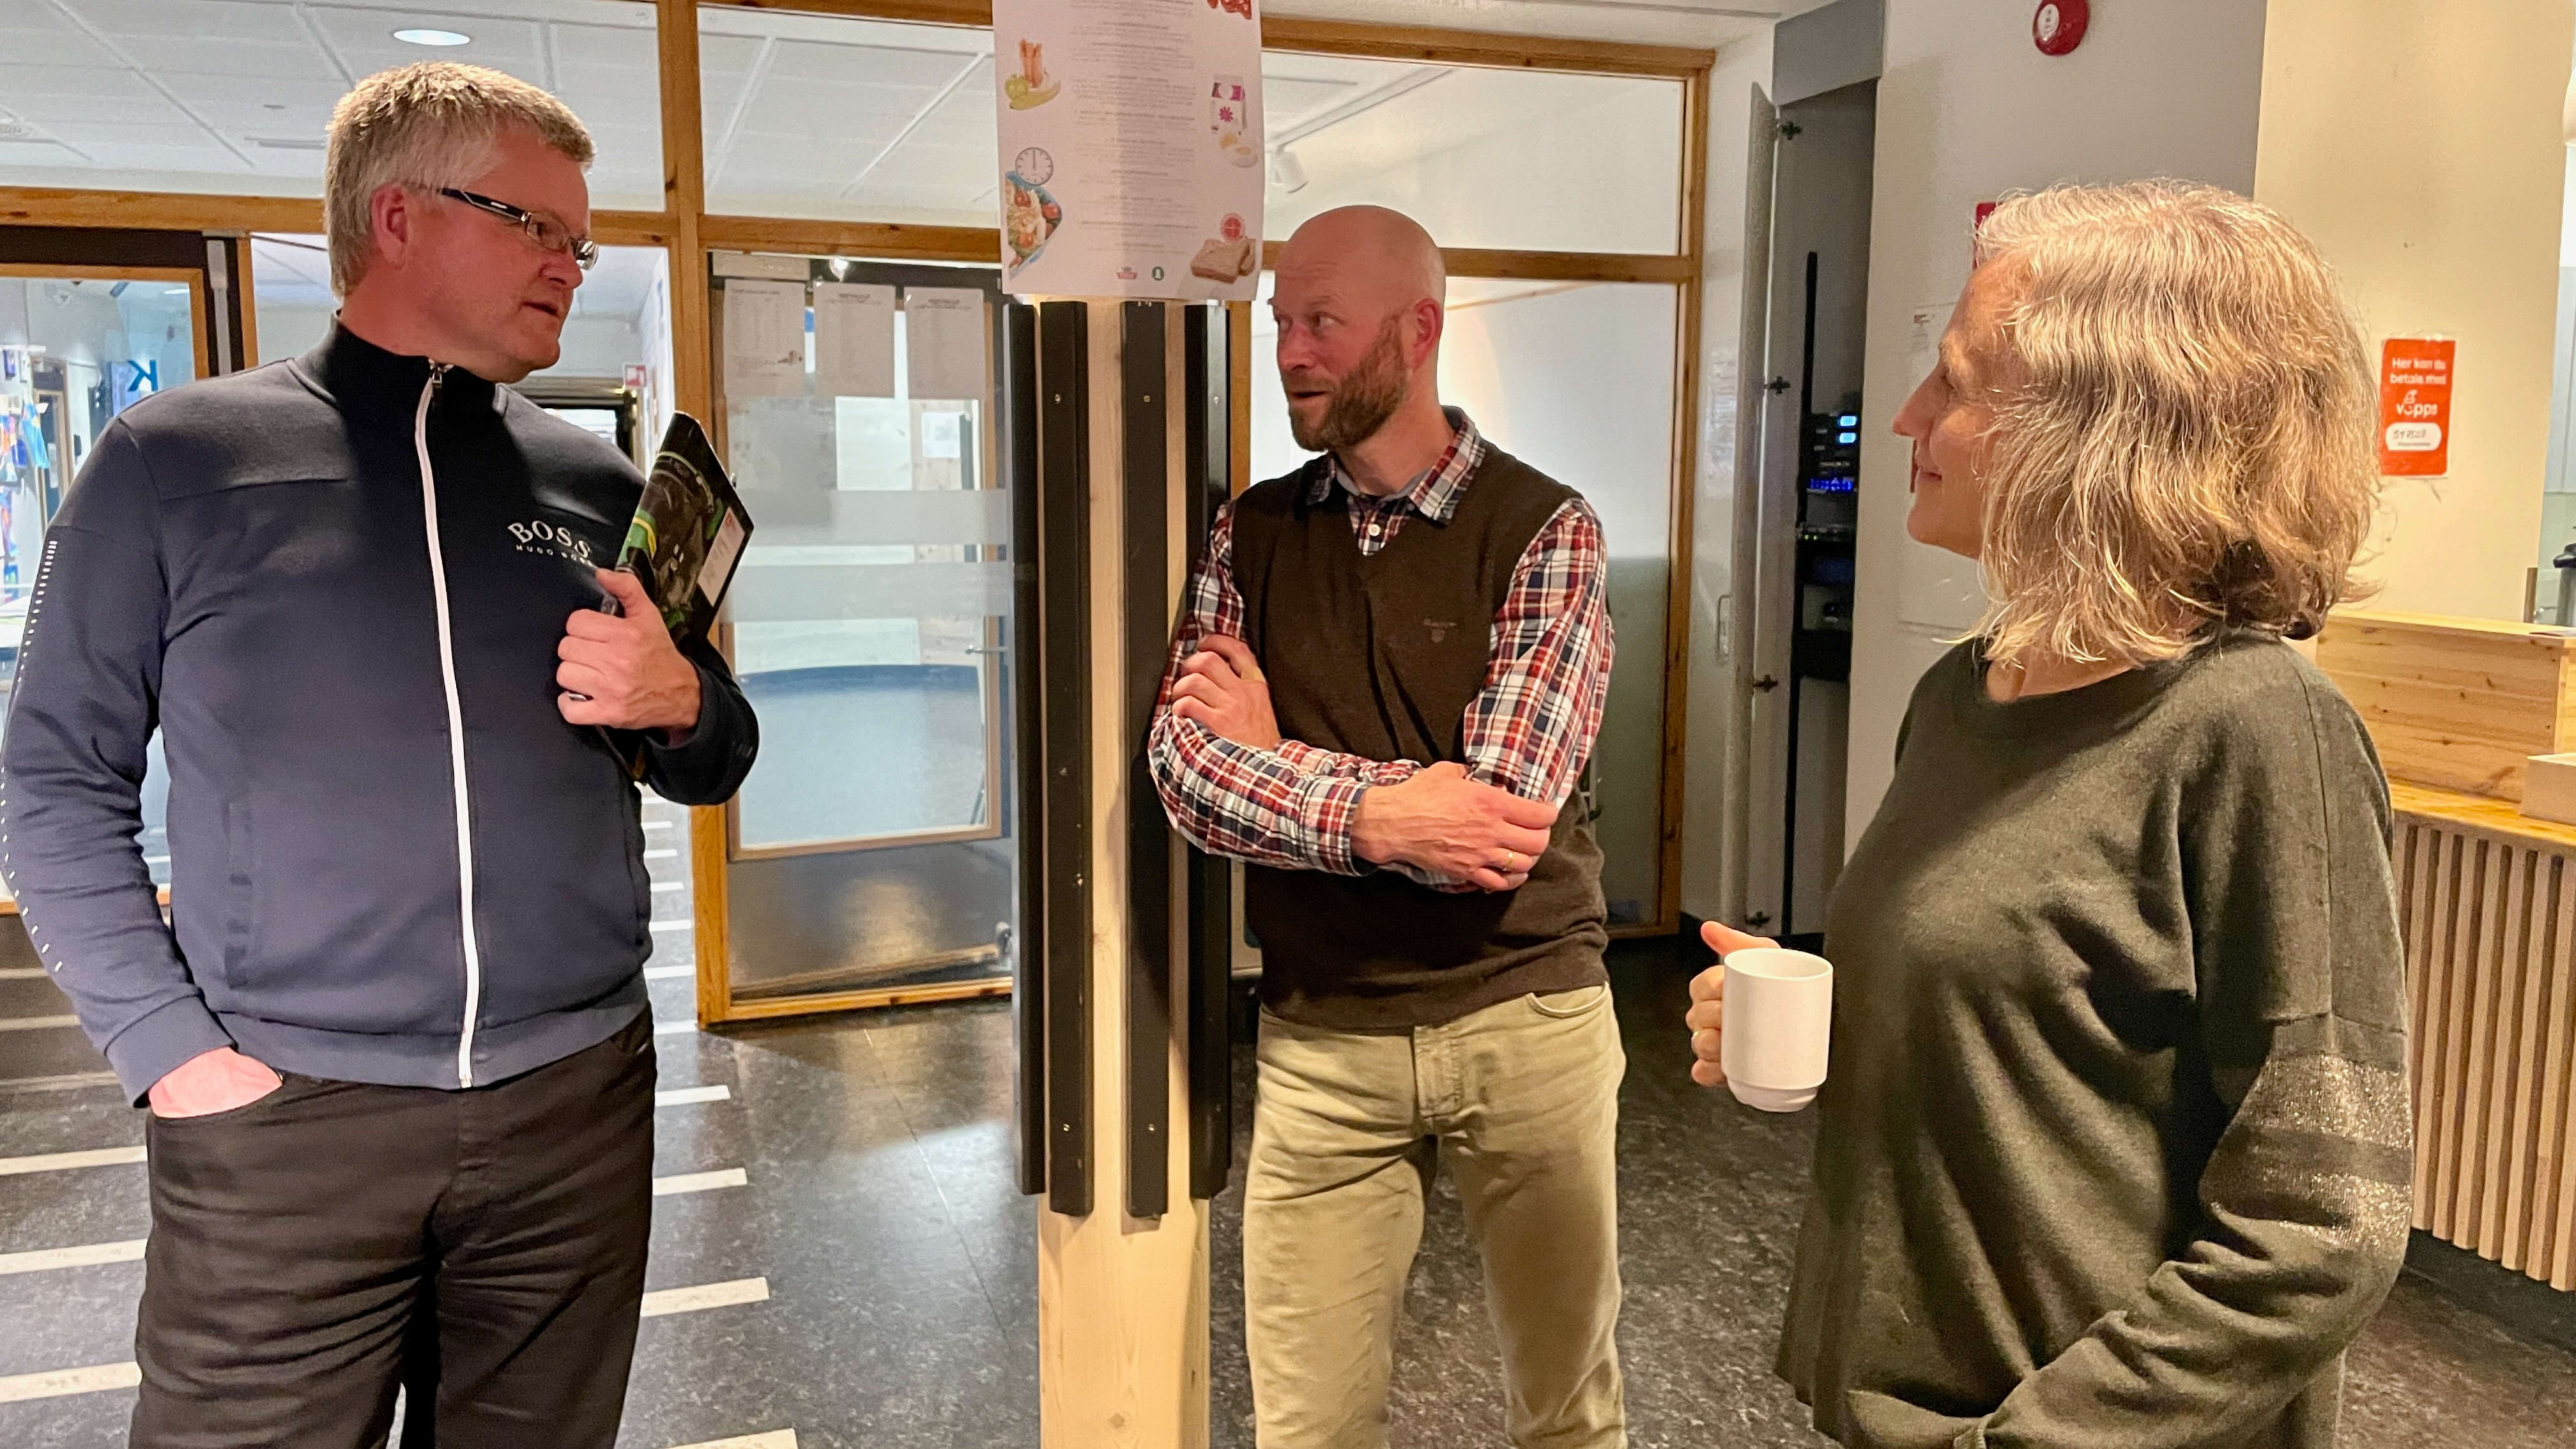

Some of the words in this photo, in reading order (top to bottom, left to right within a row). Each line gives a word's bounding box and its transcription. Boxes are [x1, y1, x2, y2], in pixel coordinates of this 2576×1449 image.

[2392, 357, 2412, 369] Her
[2414, 357, 2432, 369] kan
[2390, 373, 2423, 384] betale
[507, 520, 592, 558] BOSS
[516, 544, 554, 556] HUGO
